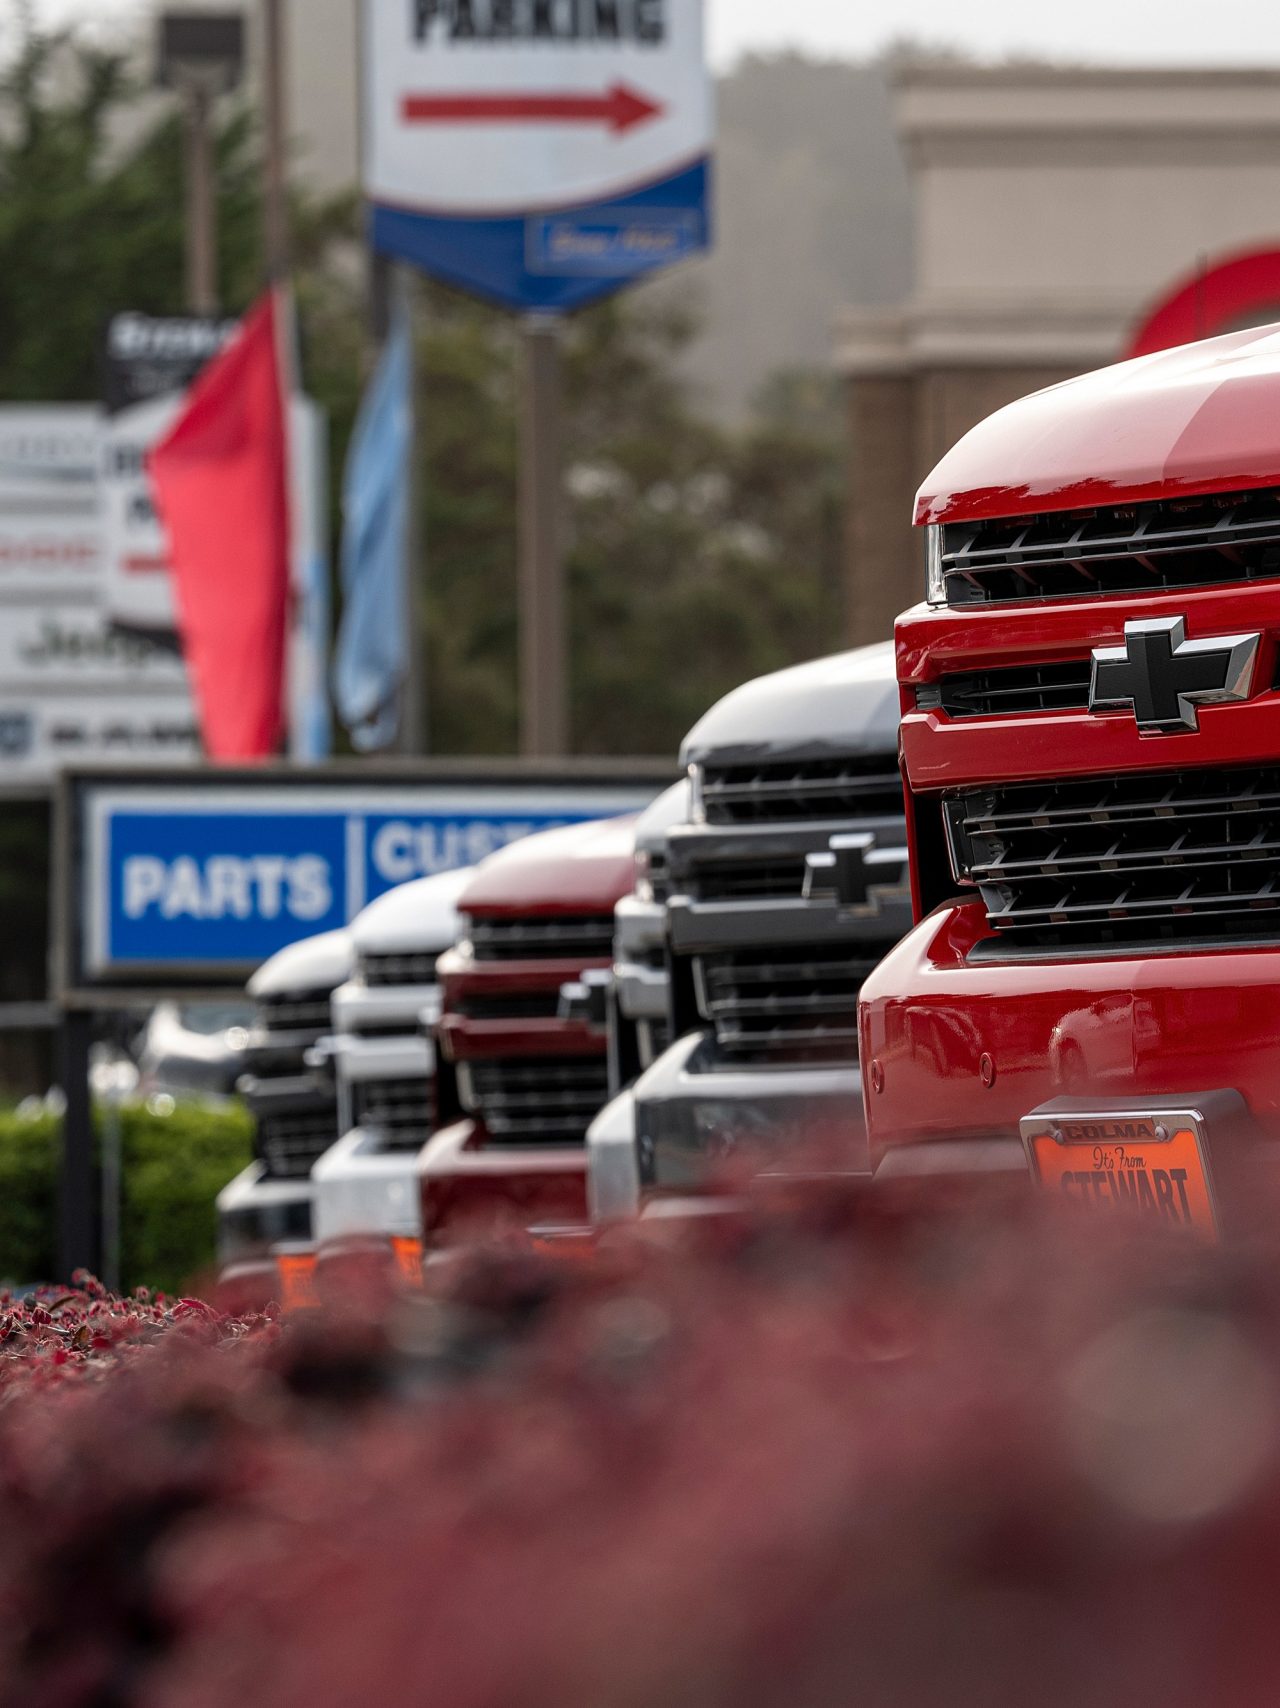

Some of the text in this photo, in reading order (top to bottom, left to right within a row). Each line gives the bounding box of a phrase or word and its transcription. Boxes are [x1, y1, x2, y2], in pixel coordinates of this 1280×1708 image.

[412, 0, 666, 46] PARKING
[371, 818, 570, 884] CUS
[121, 854, 332, 920] PARTS
[1064, 1123, 1155, 1140] COLMA
[1093, 1146, 1147, 1170] It's From
